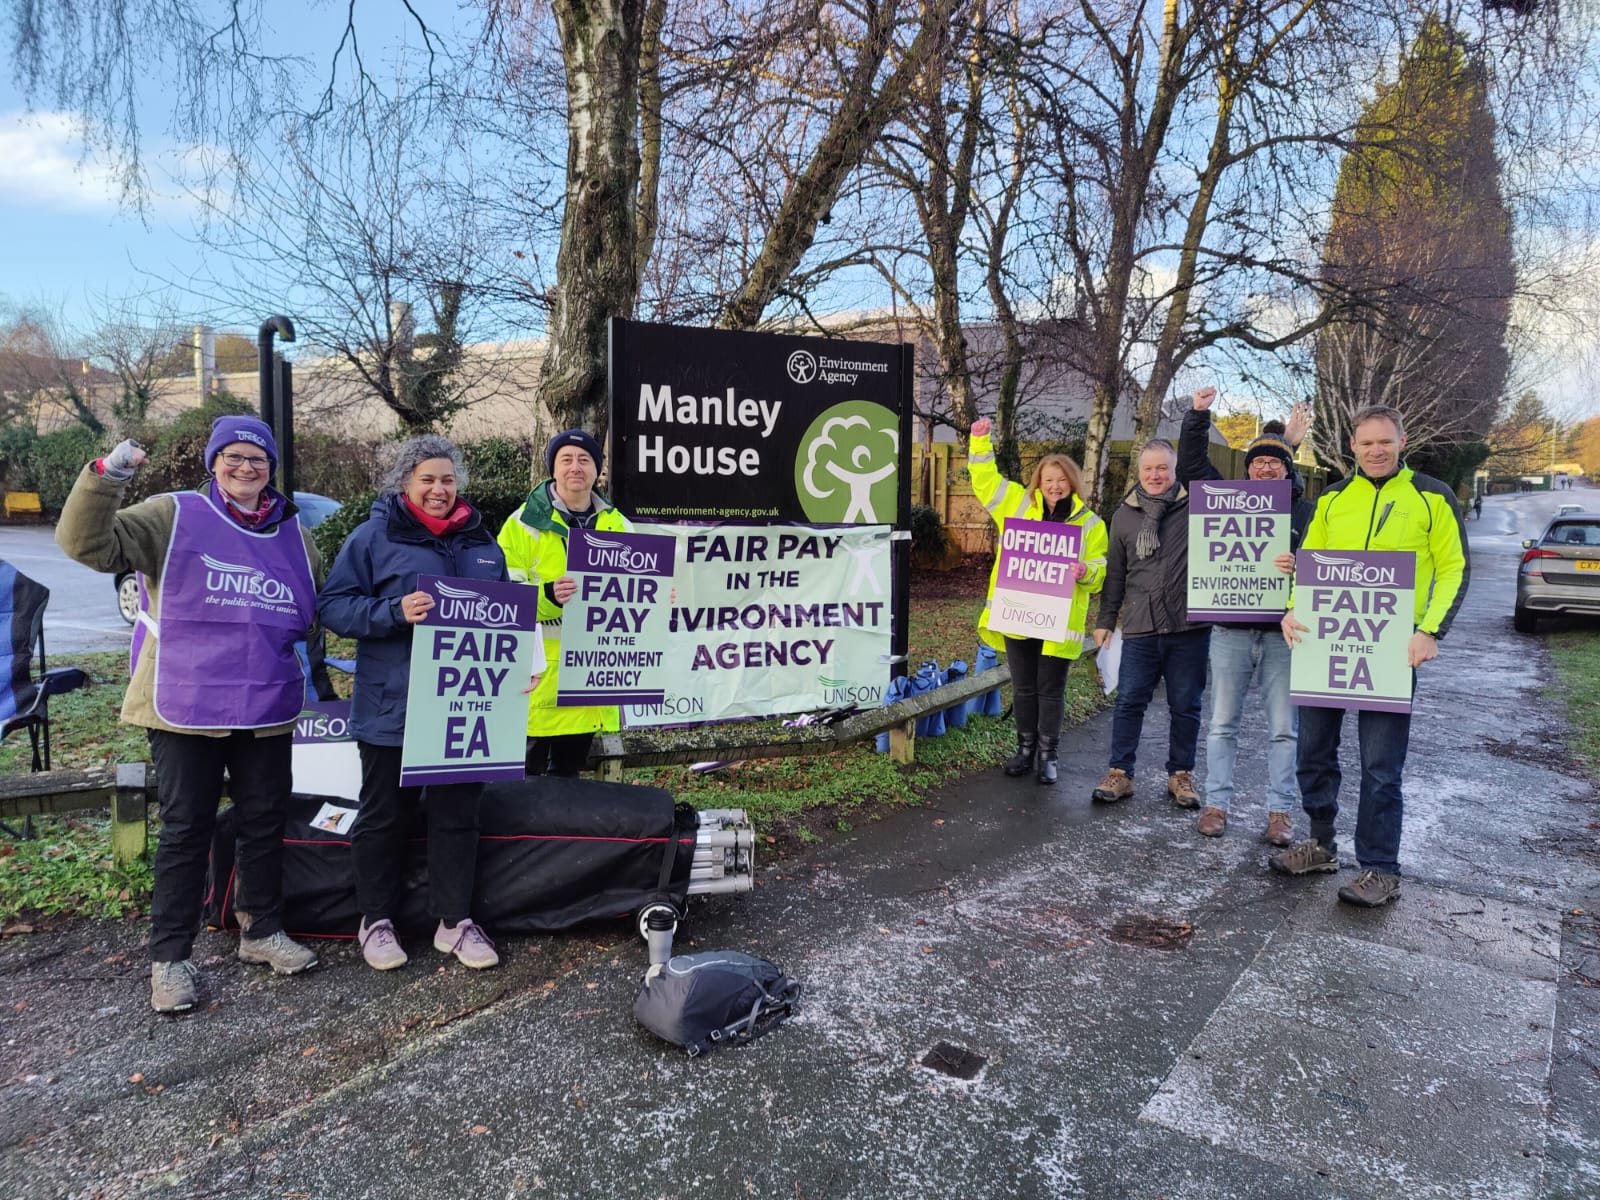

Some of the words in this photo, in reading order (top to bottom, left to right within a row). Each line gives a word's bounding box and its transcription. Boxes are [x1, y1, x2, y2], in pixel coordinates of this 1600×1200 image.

[818, 356, 888, 373] Environment
[818, 371, 858, 385] Agency
[638, 383, 782, 438] Manley
[638, 435, 760, 476] House
[635, 505, 779, 518] www.environment-agency.gov.uk
[1206, 495, 1273, 510] UNISON
[1203, 517, 1275, 538] FAIR
[686, 535, 769, 563] FAIR
[777, 535, 843, 560] PAY
[1003, 528, 1078, 558] OFFICIAL
[1209, 541, 1269, 562] PAY
[588, 549, 658, 570] UNISON
[1220, 565, 1231, 573] IN
[1234, 565, 1256, 573] THE
[1580, 561, 1600, 570] CX7
[726, 572, 750, 590] IN
[757, 570, 800, 588] THE
[1007, 556, 1070, 585] PICKET
[1316, 565, 1395, 583] UNISON
[206, 571, 294, 602] UNISON
[581, 575, 658, 604] FAIR
[1192, 577, 1285, 591] ENVIRONMENT
[205, 595, 220, 604] the
[221, 597, 249, 607] public
[250, 600, 276, 611] service
[276, 605, 298, 615] union
[1211, 593, 1264, 606] AGENCY
[1312, 589, 1397, 615] FAIR
[439, 598, 518, 623] UNISON
[586, 606, 651, 633] PAY
[669, 602, 884, 633] VIRONMENT
[1002, 607, 1057, 628] UNISON
[1318, 617, 1390, 643] PAY
[432, 629, 519, 663] FAIR
[597, 636, 609, 646] IN
[613, 636, 636, 646] THE
[1330, 643, 1343, 653] IN
[1348, 644, 1374, 654] THE
[564, 650, 664, 667] ENVIRONMENT
[691, 639, 835, 671] AGENCY
[436, 666, 510, 697] PAY
[585, 670, 642, 687] AGENCY
[1328, 655, 1374, 691] EA
[823, 686, 881, 705] UNISON
[449, 701, 463, 712] IN
[467, 701, 492, 712] THE
[633, 697, 704, 718] UNISON
[293, 718, 350, 737] NISO
[444, 716, 490, 759] EA
